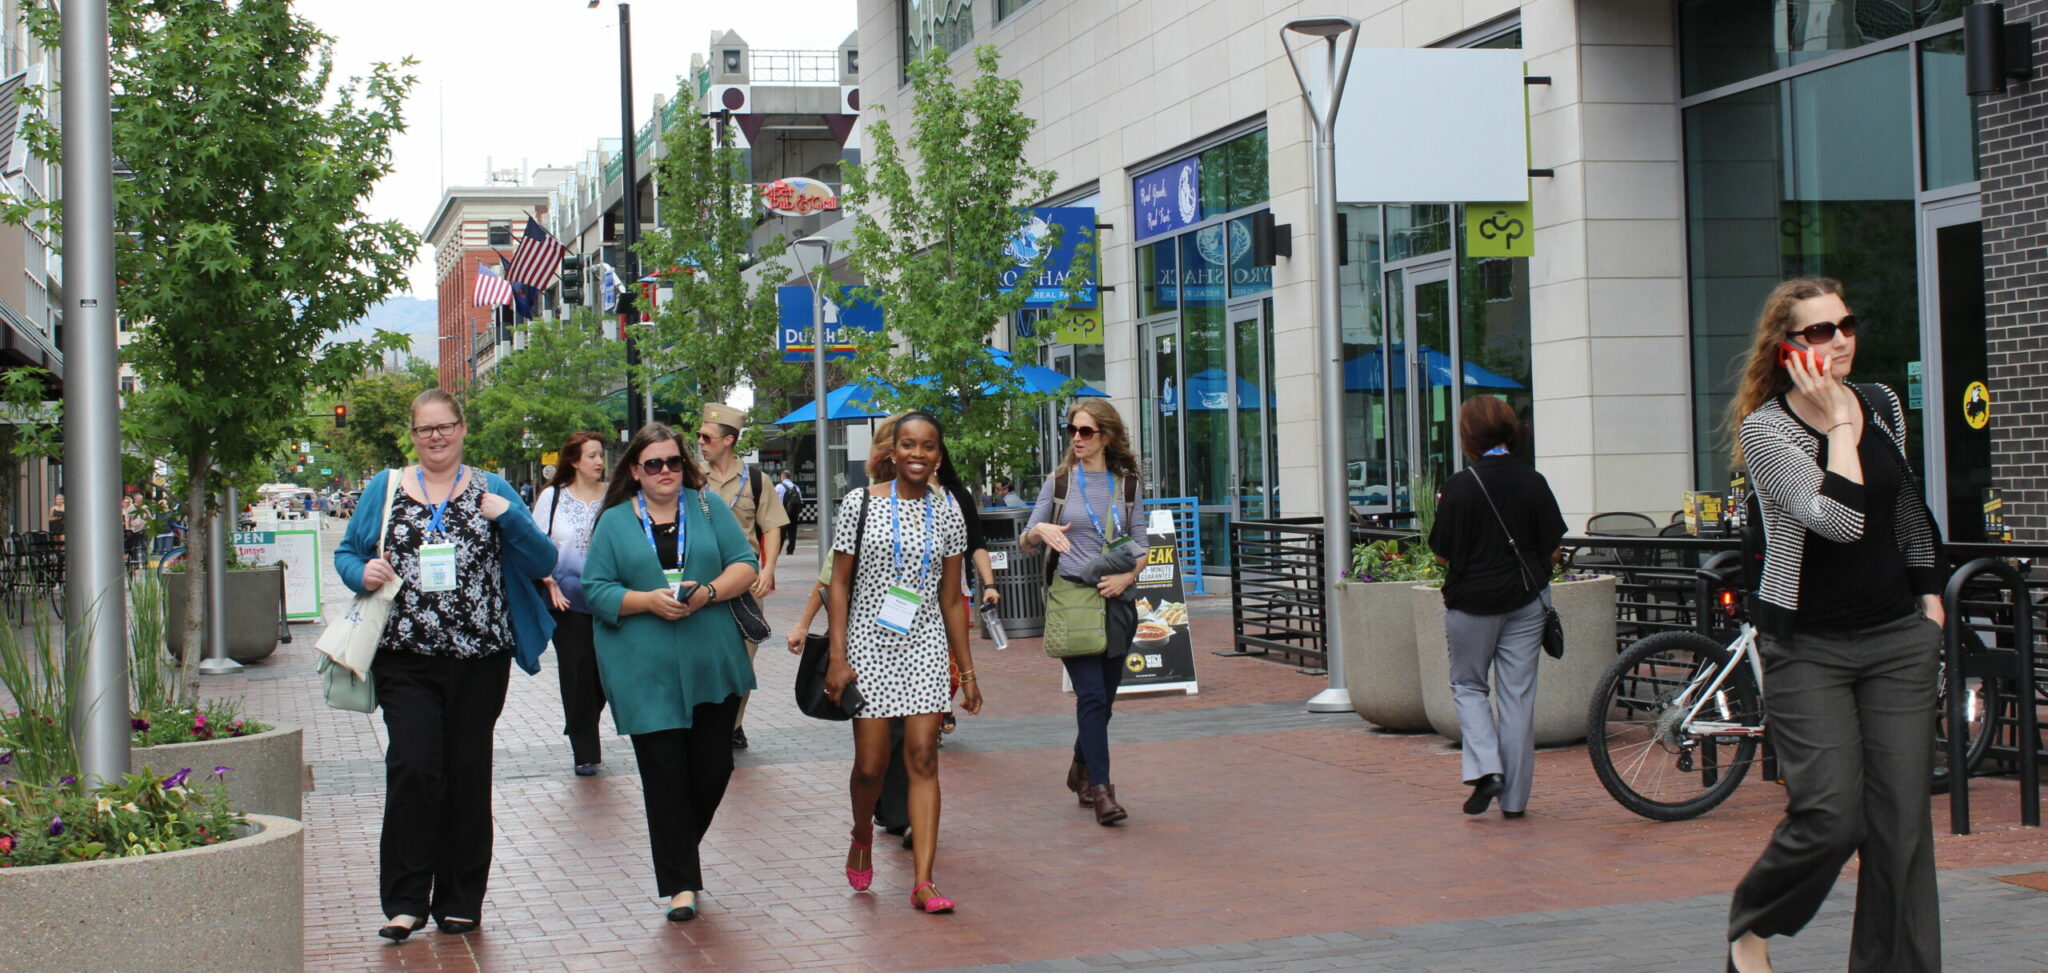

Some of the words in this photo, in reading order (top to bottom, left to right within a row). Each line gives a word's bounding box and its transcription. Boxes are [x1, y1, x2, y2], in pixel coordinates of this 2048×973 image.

[1034, 291, 1056, 299] REAL
[233, 532, 265, 544] PEN
[1148, 548, 1174, 565] EAK
[1141, 573, 1172, 581] GUARANTEE
